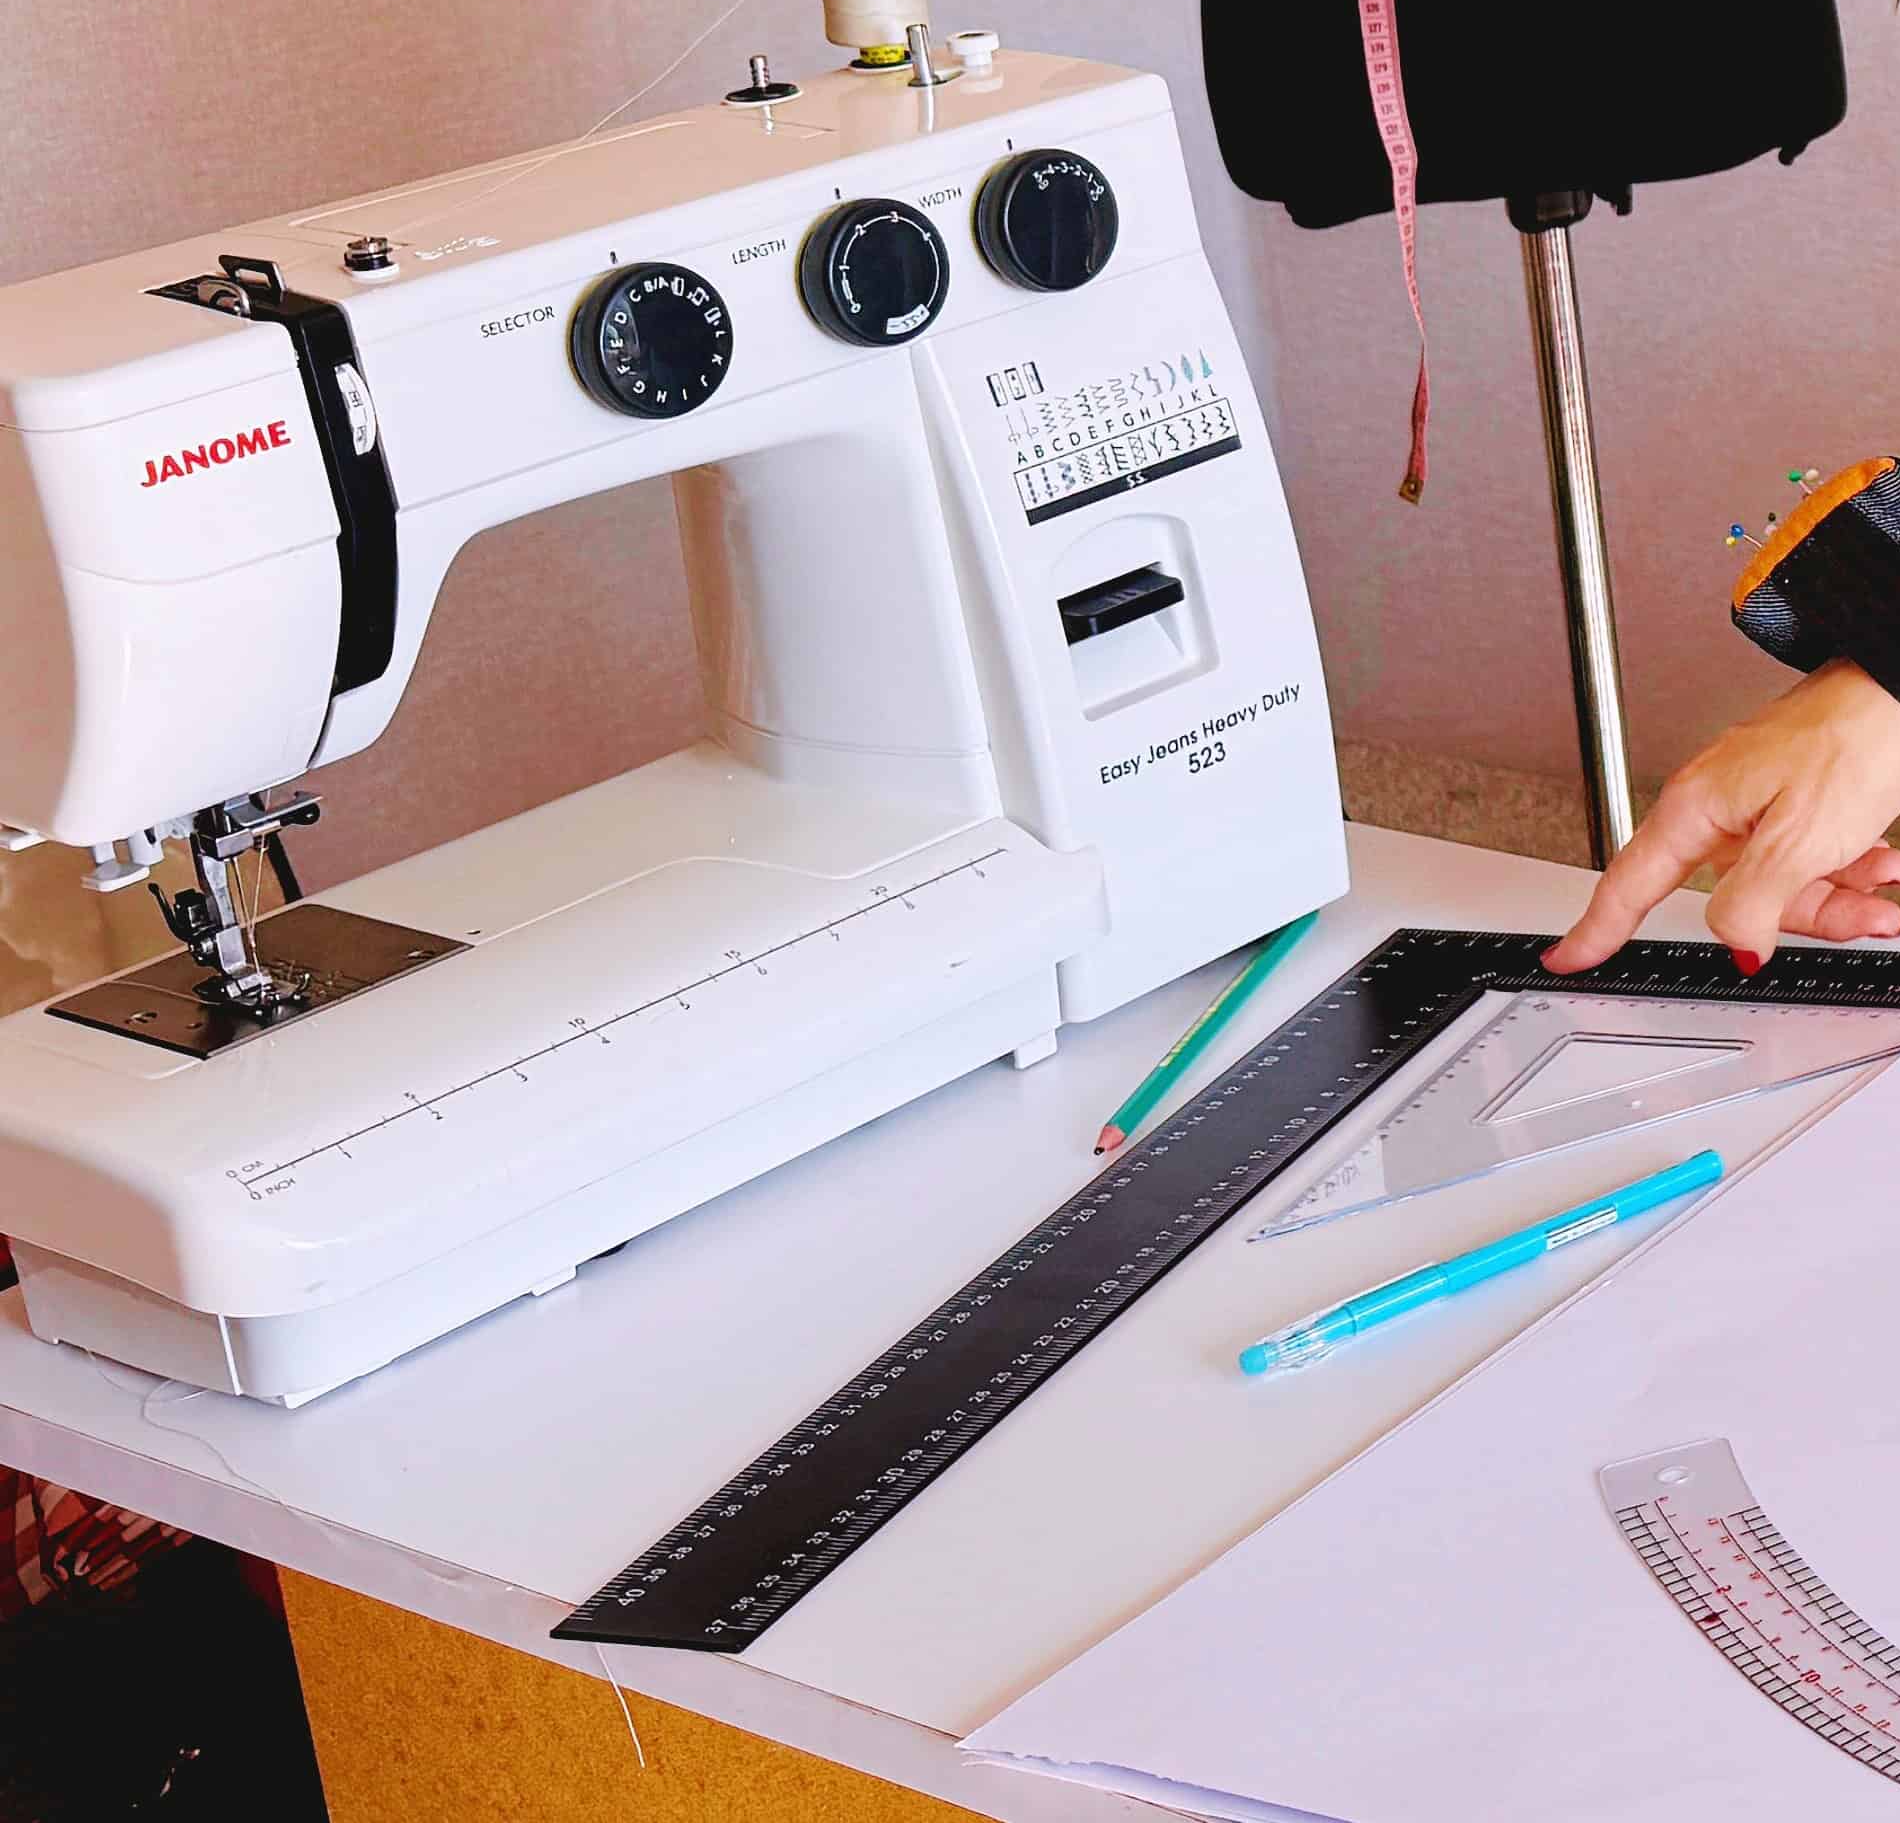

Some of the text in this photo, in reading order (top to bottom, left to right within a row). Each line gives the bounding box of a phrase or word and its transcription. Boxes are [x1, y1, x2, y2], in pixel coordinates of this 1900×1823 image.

[919, 187, 962, 209] WIDTH
[733, 239, 787, 264] LENGTH
[615, 312, 627, 324] D
[630, 290, 641, 302] C
[480, 305, 555, 339] SELECTOR
[141, 420, 291, 488] JANOME
[1100, 684, 1300, 784] Easy Jeans Heavy Duty
[1188, 741, 1226, 773] 523
[1796, 979, 1816, 987] 10
[242, 1160, 264, 1173] CM
[1072, 1209, 1096, 1221] 20
[1094, 1280, 1120, 1293] 20
[1054, 1316, 1076, 1328] 22
[928, 1329, 948, 1342] 27
[1033, 1335, 1053, 1347] 23
[1012, 1354, 1033, 1365] 24
[861, 1384, 887, 1399] 30
[840, 1405, 862, 1416] 31
[947, 1410, 967, 1423] 27
[816, 1424, 839, 1435] 32
[792, 1444, 815, 1456] 33
[769, 1464, 791, 1476] 34
[877, 1468, 905, 1483] 30
[744, 1484, 767, 1496] 35
[856, 1490, 879, 1502] 31
[831, 1510, 855, 1523] 32
[694, 1525, 716, 1538] 37
[806, 1531, 830, 1544] 33
[782, 1553, 805, 1566] 34
[642, 1569, 666, 1583] 39
[756, 1575, 780, 1589] 35
[618, 1589, 645, 1606] 40
[731, 1596, 754, 1611] 36
[705, 1619, 727, 1634] 37
